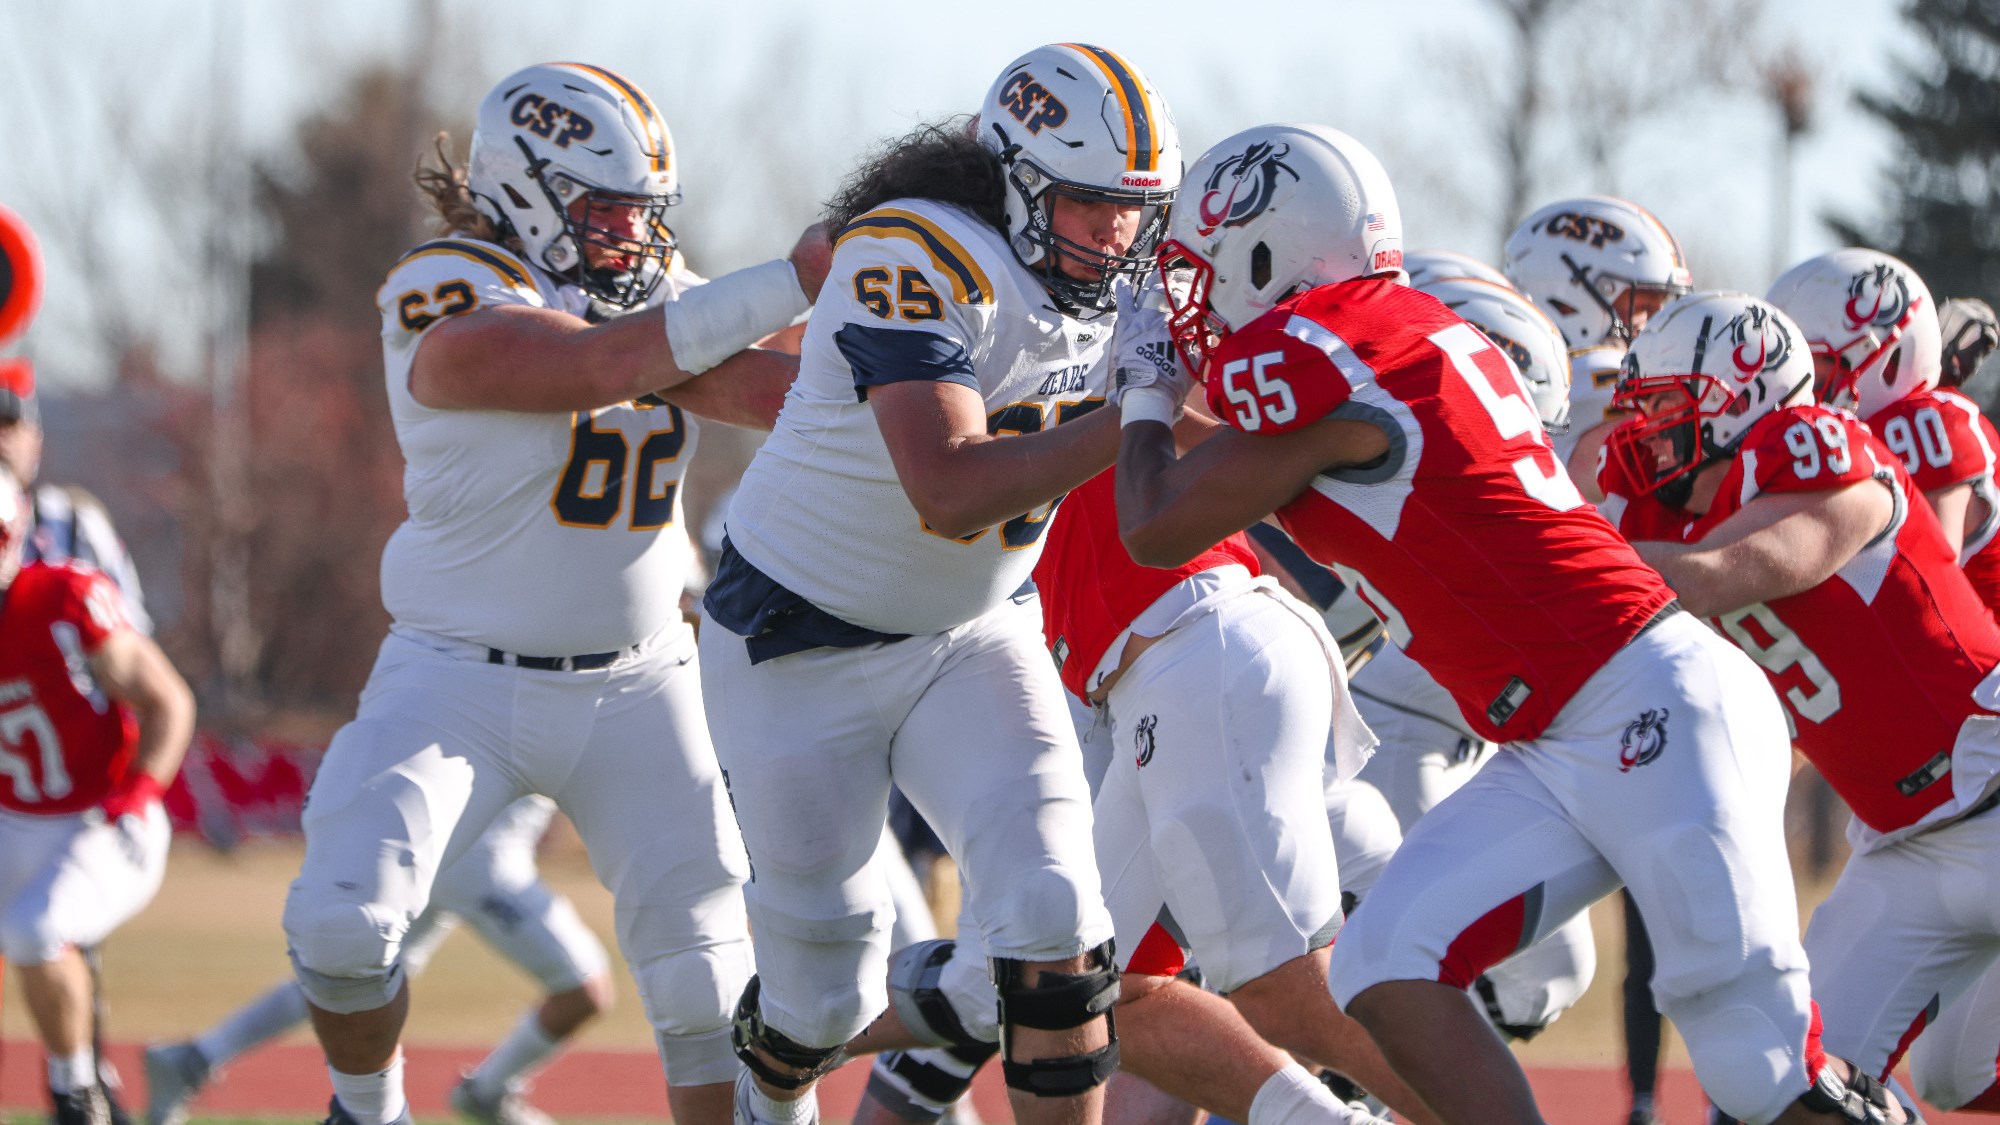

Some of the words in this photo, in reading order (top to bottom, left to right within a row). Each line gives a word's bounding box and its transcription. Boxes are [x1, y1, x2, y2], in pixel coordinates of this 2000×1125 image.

[510, 93, 594, 149] CSP
[998, 72, 1069, 137] CSP
[1546, 213, 1625, 249] CSP
[852, 266, 946, 323] 65
[1136, 345, 1178, 377] adidas
[1222, 350, 1298, 432] 55
[1783, 415, 1852, 480] 99
[1884, 407, 1952, 475] 90
